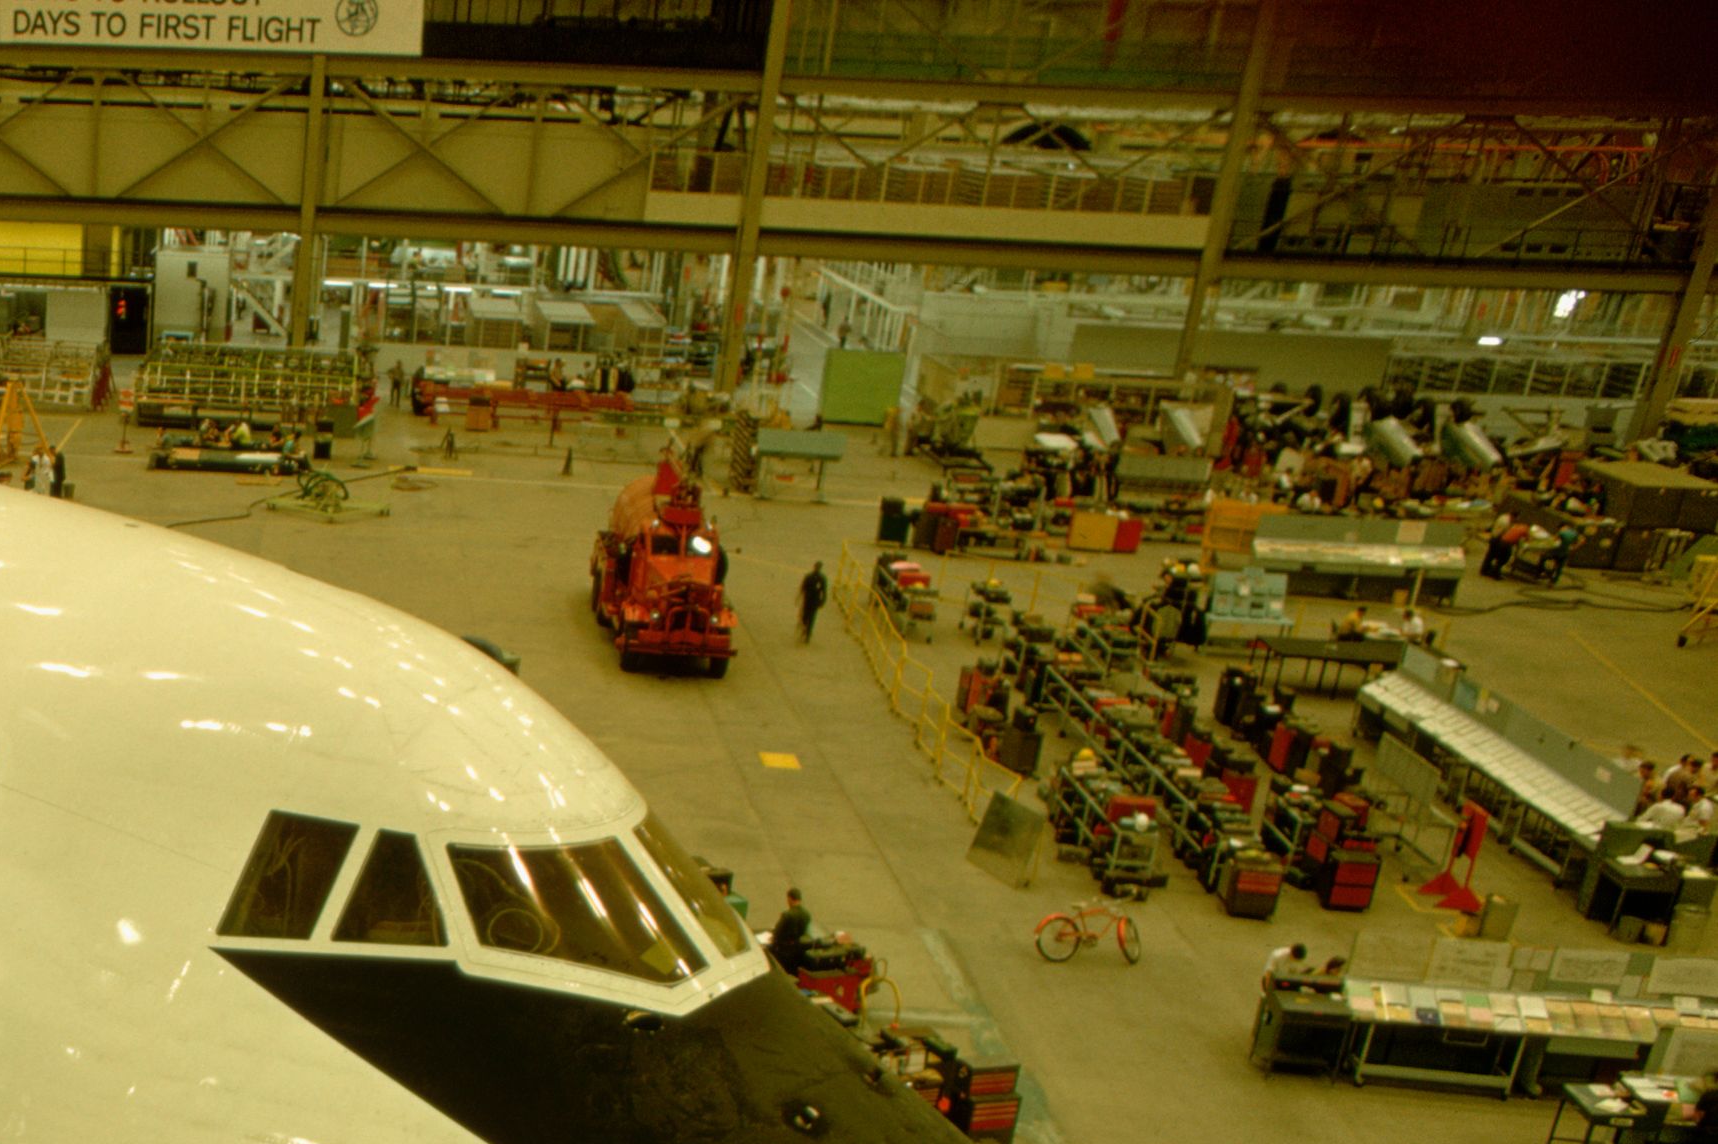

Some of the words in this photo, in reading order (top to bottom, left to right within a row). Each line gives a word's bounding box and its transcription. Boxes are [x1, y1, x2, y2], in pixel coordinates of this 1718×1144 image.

[13, 10, 81, 36] DAYS
[91, 12, 127, 37] TO
[139, 13, 217, 41] FIRST
[227, 16, 321, 43] FLIGHT
